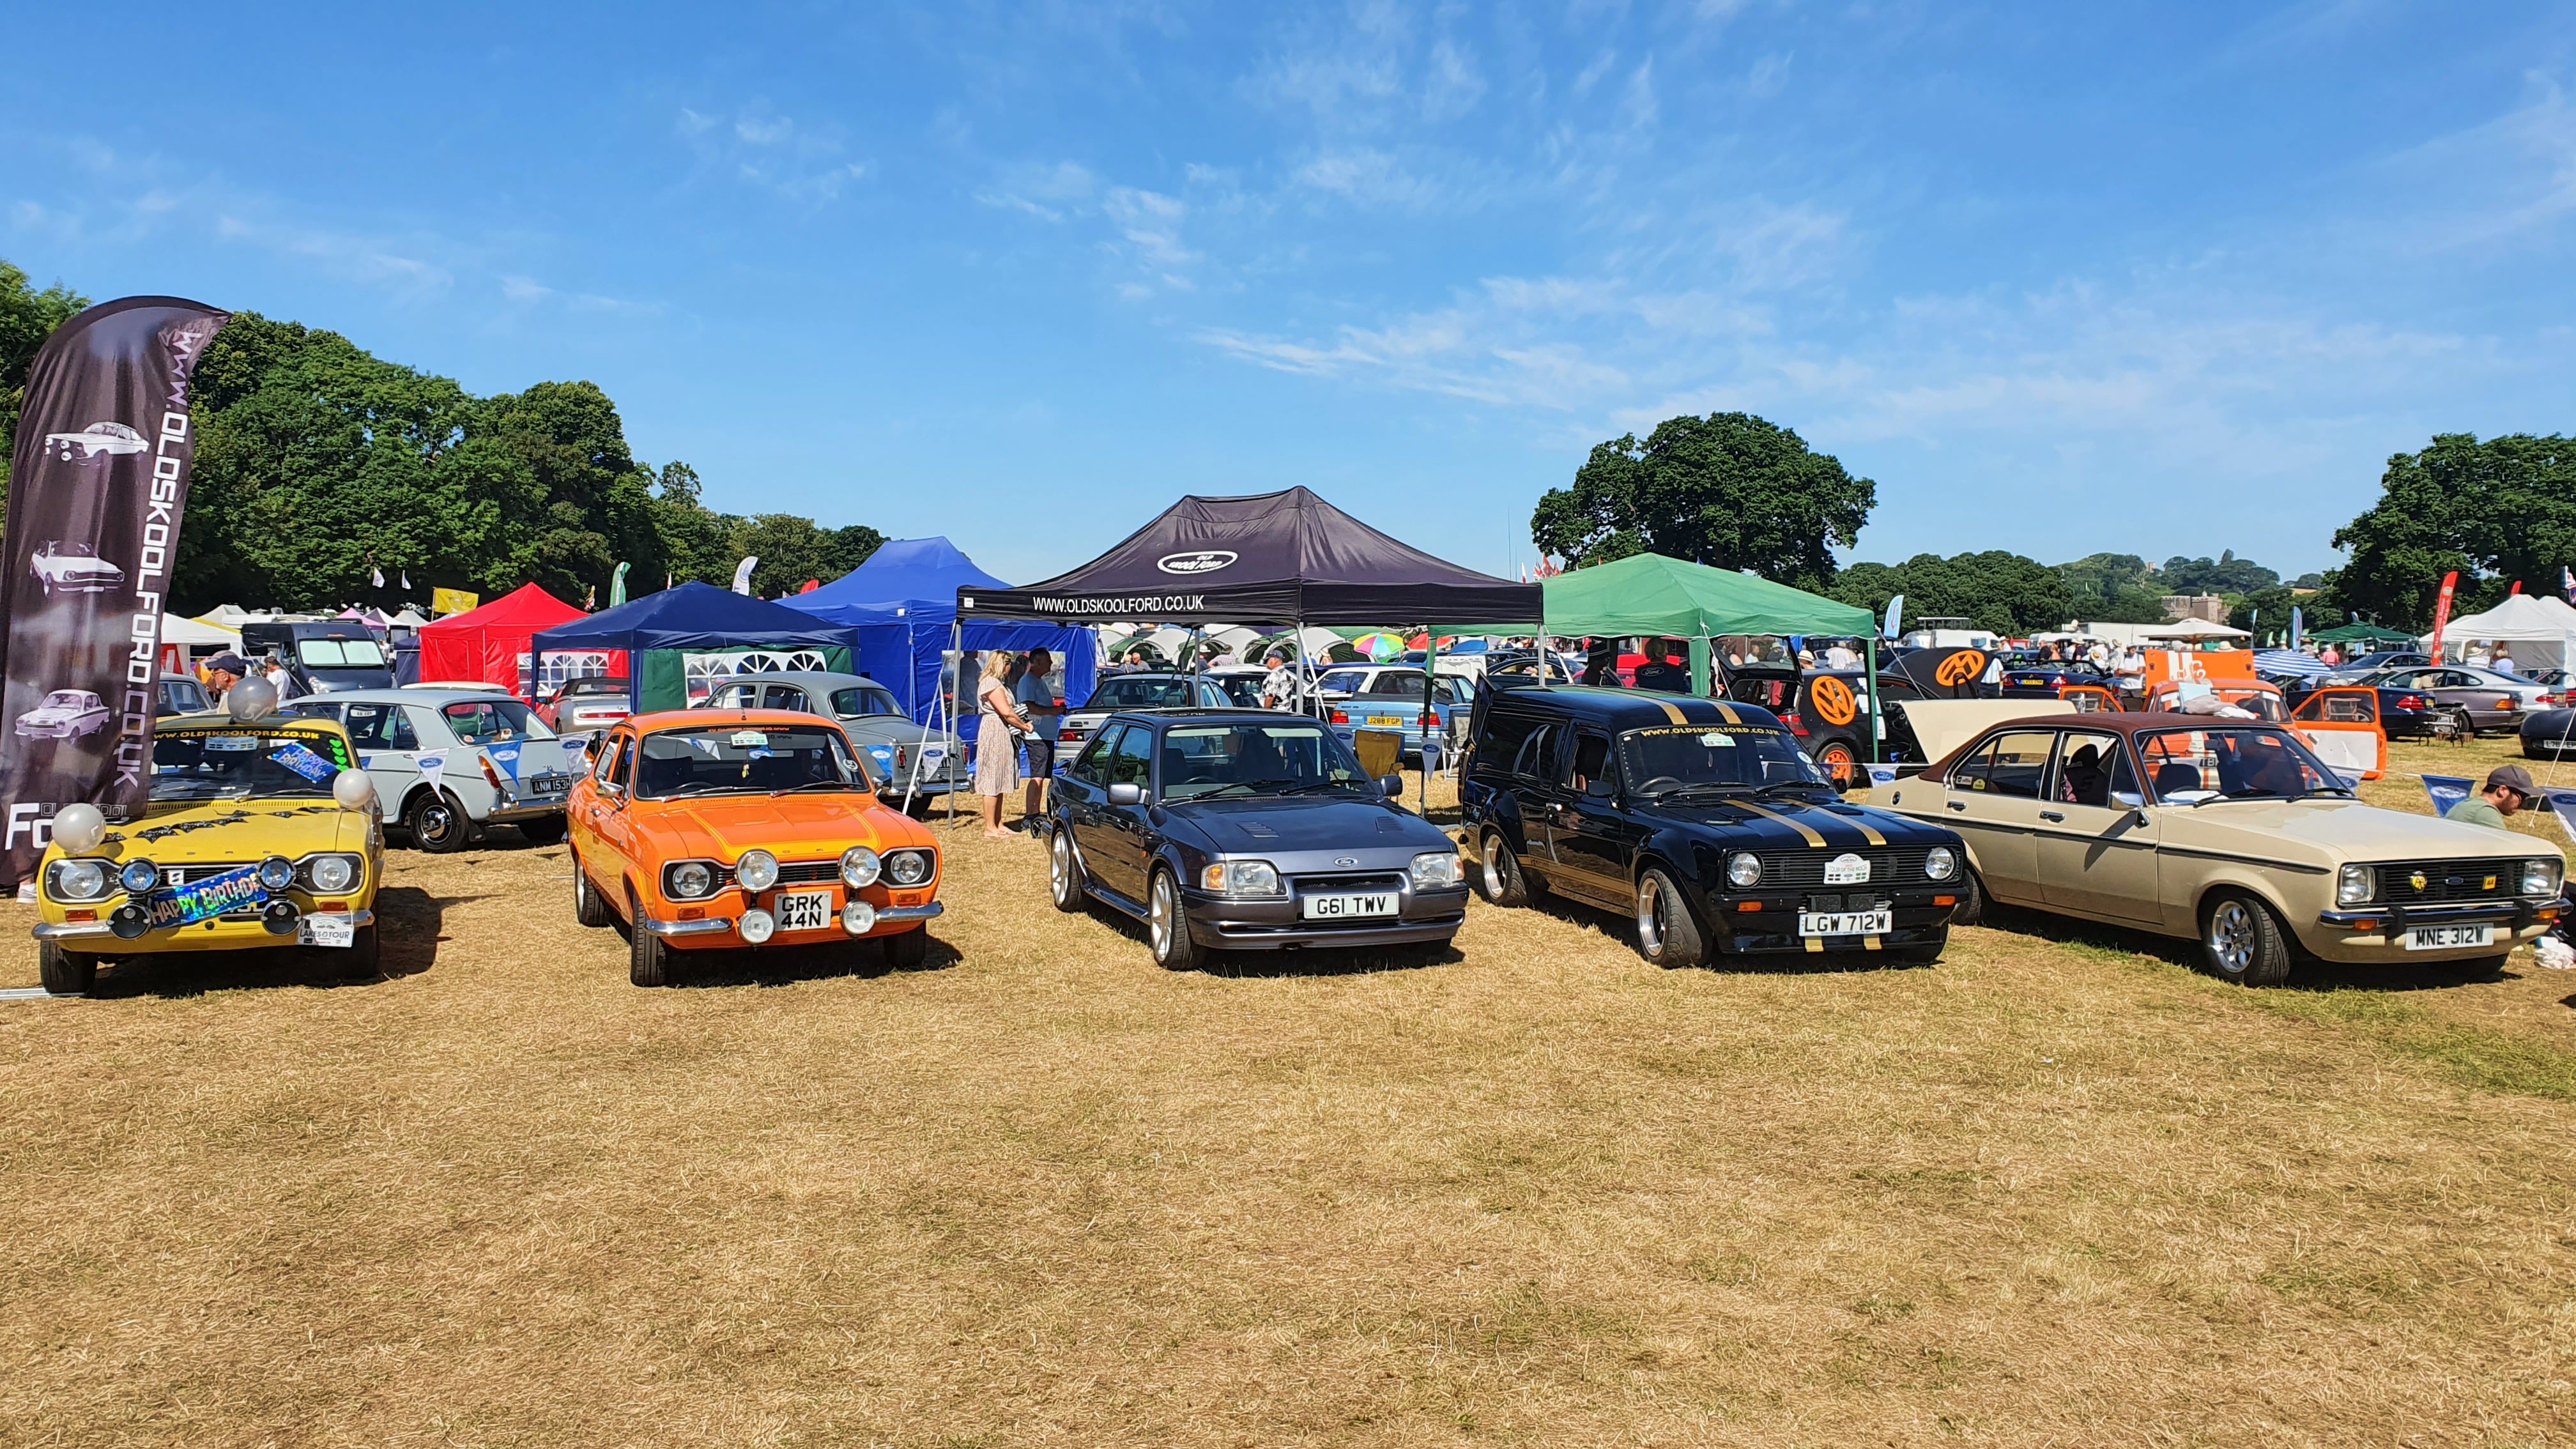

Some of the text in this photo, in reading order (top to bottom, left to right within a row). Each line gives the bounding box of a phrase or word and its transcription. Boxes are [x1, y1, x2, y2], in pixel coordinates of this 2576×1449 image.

[114, 330, 203, 788] WWW.OLDSKOOLFORD.CO.UK
[1033, 595, 1204, 613] WWW.OLDSKOOLFORD.CO.UK
[1644, 666, 1660, 675] Ford
[153, 730, 319, 740] WW.OLDSKOOLFORD.CO.UK
[1641, 727, 1781, 736] WWW.OLDSKOOLFORD.CO.UK
[279, 753, 326, 778] BIRTHDAY
[292, 748, 328, 769] HAPPY
[535, 779, 572, 792] ANM 153H
[150, 873, 260, 926] HAPPY BIRTHDA
[782, 895, 823, 912] GRK
[1317, 896, 1386, 914] G61 TWV
[781, 910, 821, 928] 44N
[1805, 914, 1886, 932] LGW 712W
[299, 928, 350, 940] LAKES TOUR
[2416, 926, 2485, 946] MNE 312W
